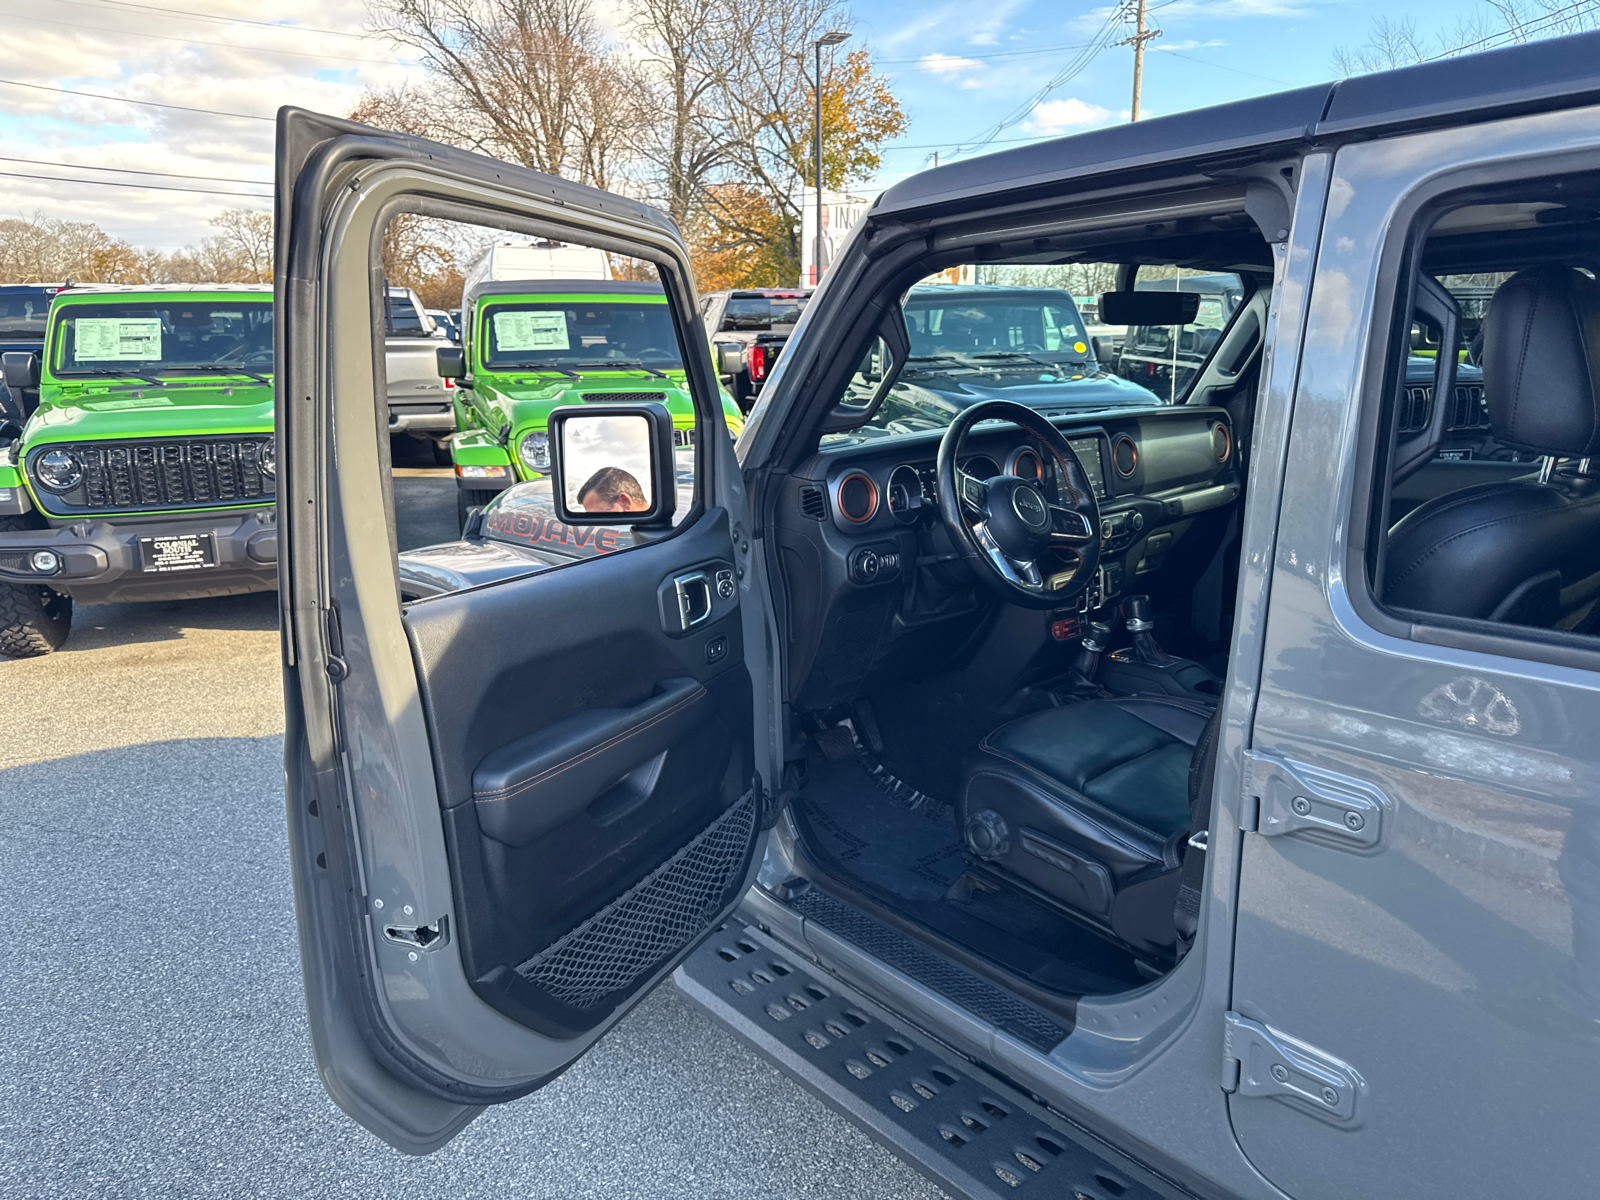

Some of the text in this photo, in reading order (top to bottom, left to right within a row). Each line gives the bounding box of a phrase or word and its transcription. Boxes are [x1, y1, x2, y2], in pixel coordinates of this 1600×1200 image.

[486, 509, 620, 553] MOJAVE
[153, 540, 199, 549] COLONIAL
[162, 546, 192, 554] SOUTH
